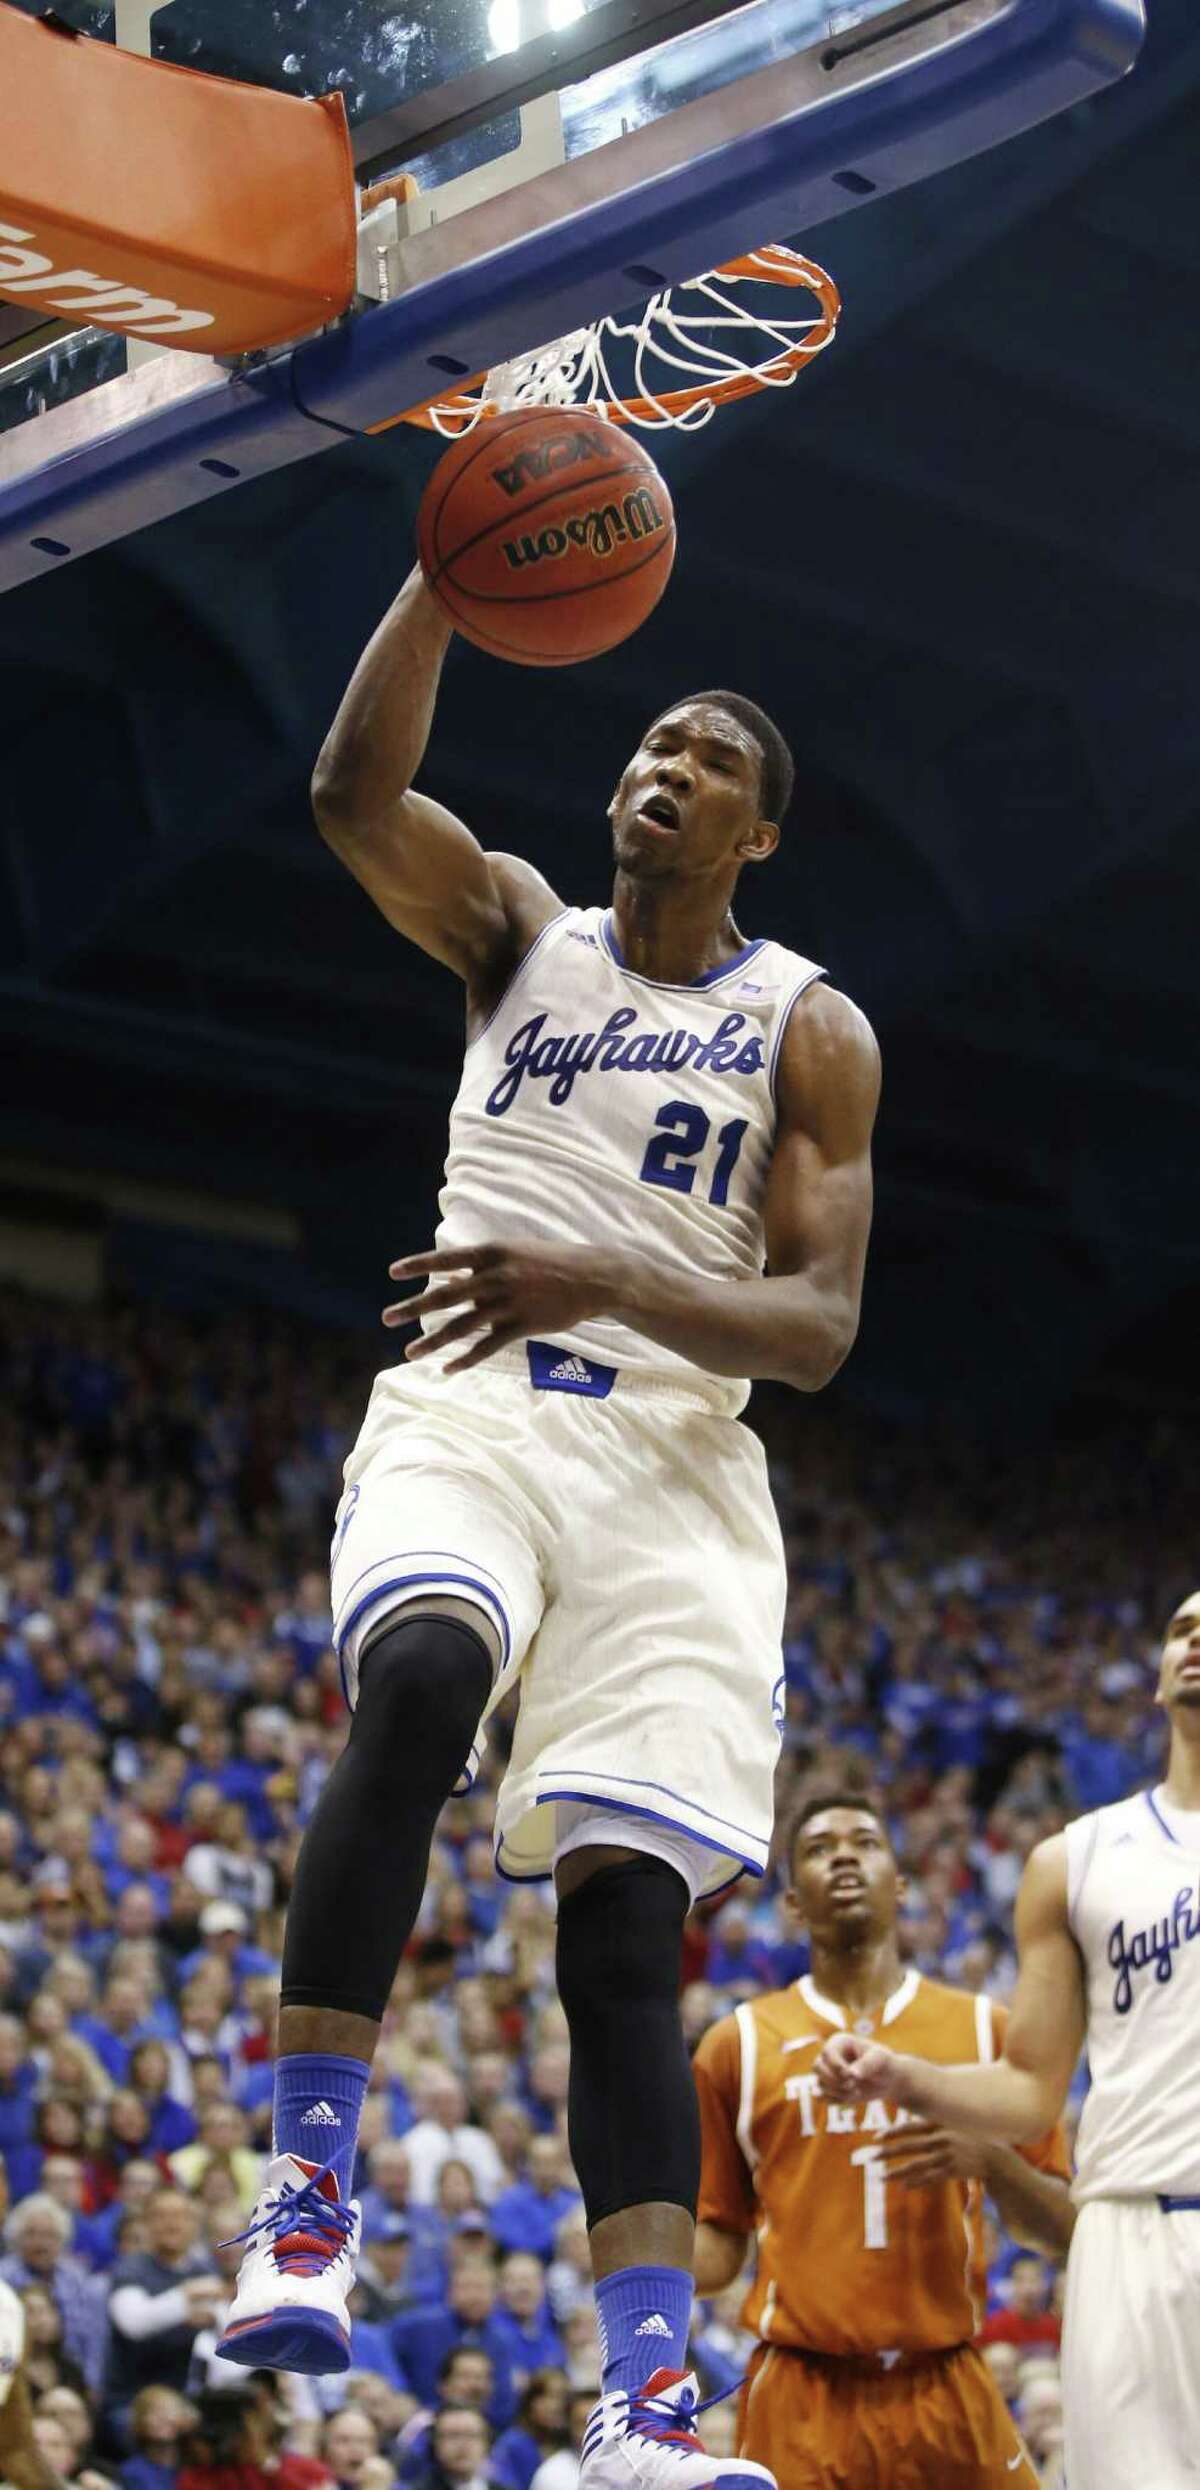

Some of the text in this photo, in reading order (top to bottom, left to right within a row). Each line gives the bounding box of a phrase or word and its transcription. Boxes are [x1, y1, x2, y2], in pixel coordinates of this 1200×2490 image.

[491, 432, 613, 496] NCAA
[502, 487, 665, 568] Wilson
[486, 1007, 766, 1117] Jayhawks
[639, 1100, 749, 1206] 21
[549, 1370, 592, 1384] adidas
[1108, 1887, 1200, 2014] Jayh
[300, 2114, 341, 2126] adidas
[850, 2144, 887, 2249] 1
